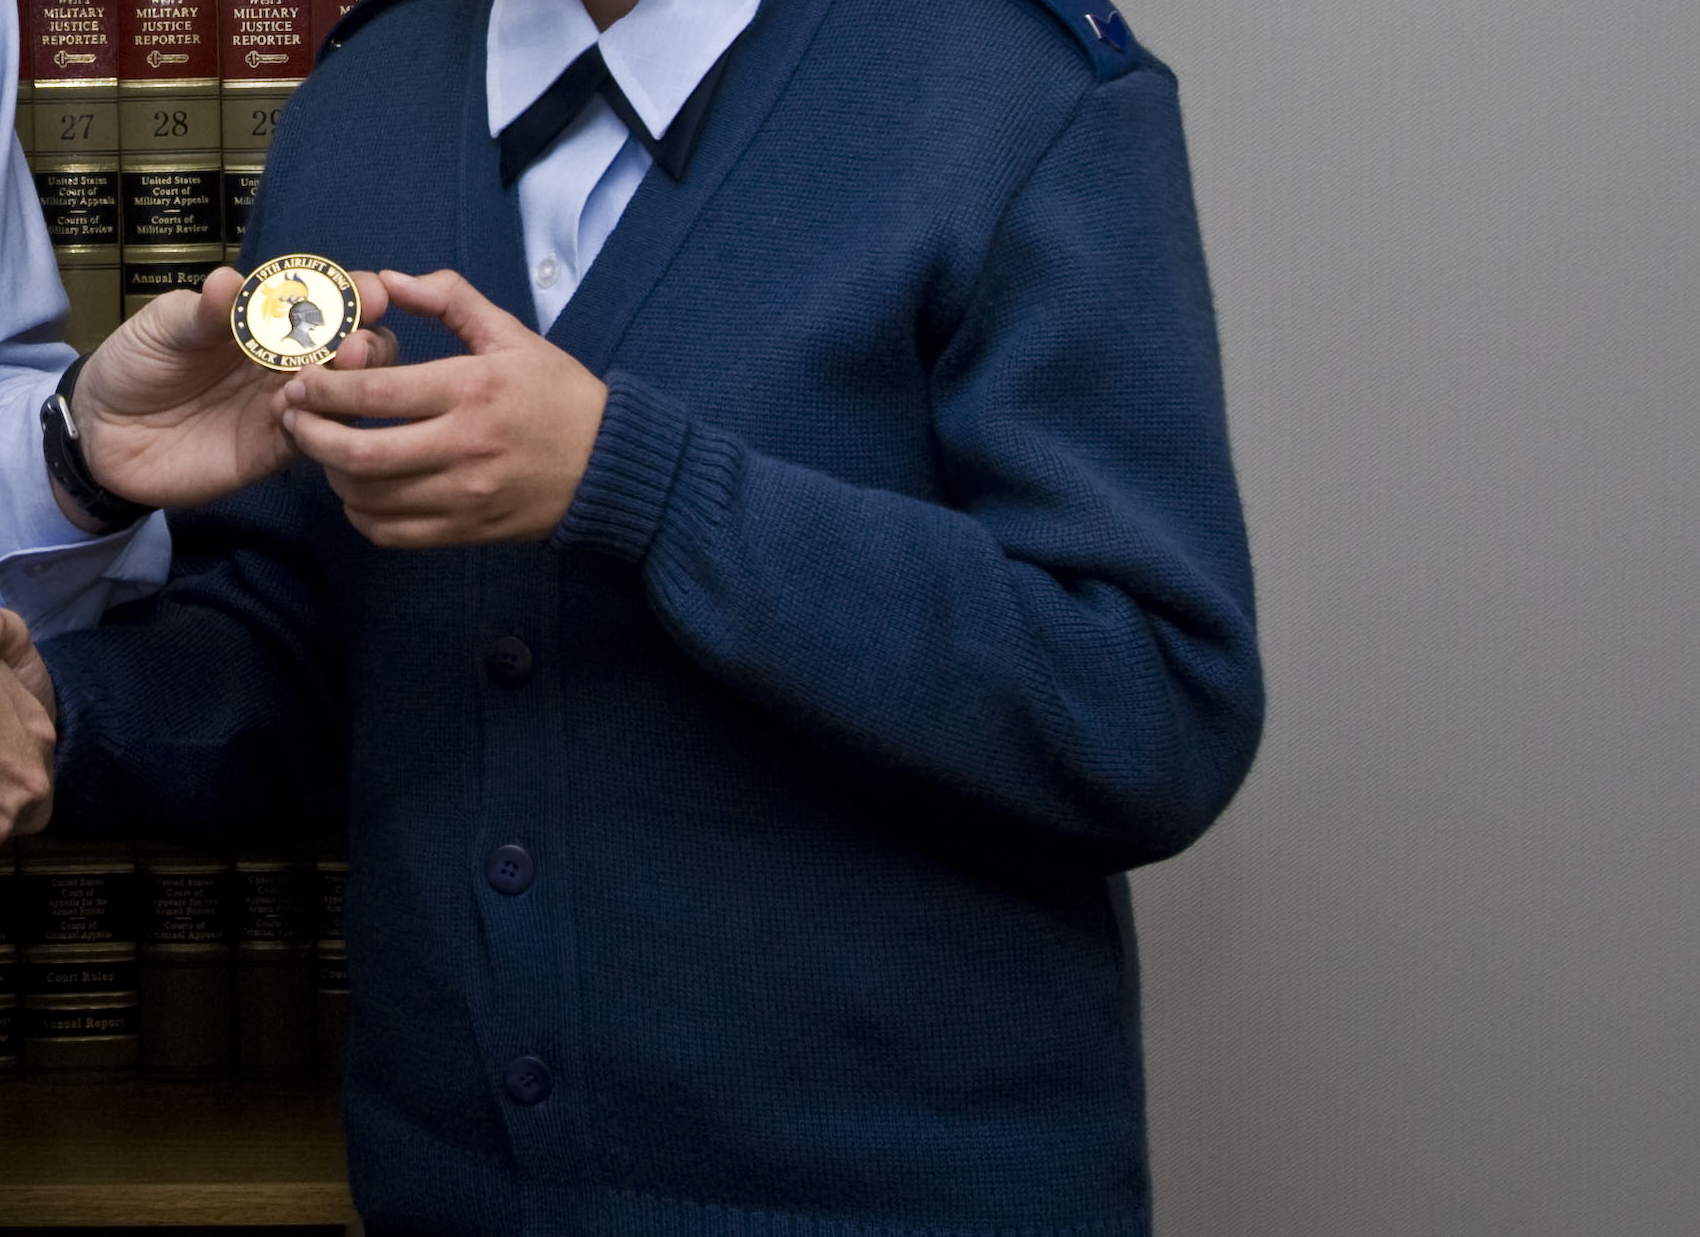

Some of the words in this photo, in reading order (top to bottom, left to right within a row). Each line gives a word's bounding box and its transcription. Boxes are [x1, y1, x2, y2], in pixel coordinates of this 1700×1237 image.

[43, 7, 105, 19] MILITARY
[136, 7, 198, 19] MILITARY
[233, 7, 299, 19] MILITARY
[48, 20, 99, 32] JUSTICE
[141, 20, 192, 32] JUSTICE
[241, 21, 293, 32] JUSTICE
[41, 34, 108, 46] REPORTER
[135, 34, 201, 45] REPORTER
[232, 34, 301, 46] REPORTER
[60, 114, 93, 140] 27
[153, 111, 188, 136] 28
[132, 273, 173, 283] Annual
[178, 272, 208, 285] Repo
[255, 262, 281, 281] 19TH
[284, 258, 327, 272] AIRLIFT
[327, 266, 350, 291] WING
[245, 339, 278, 363] BLACK
[281, 347, 331, 366] KNIGHTS
